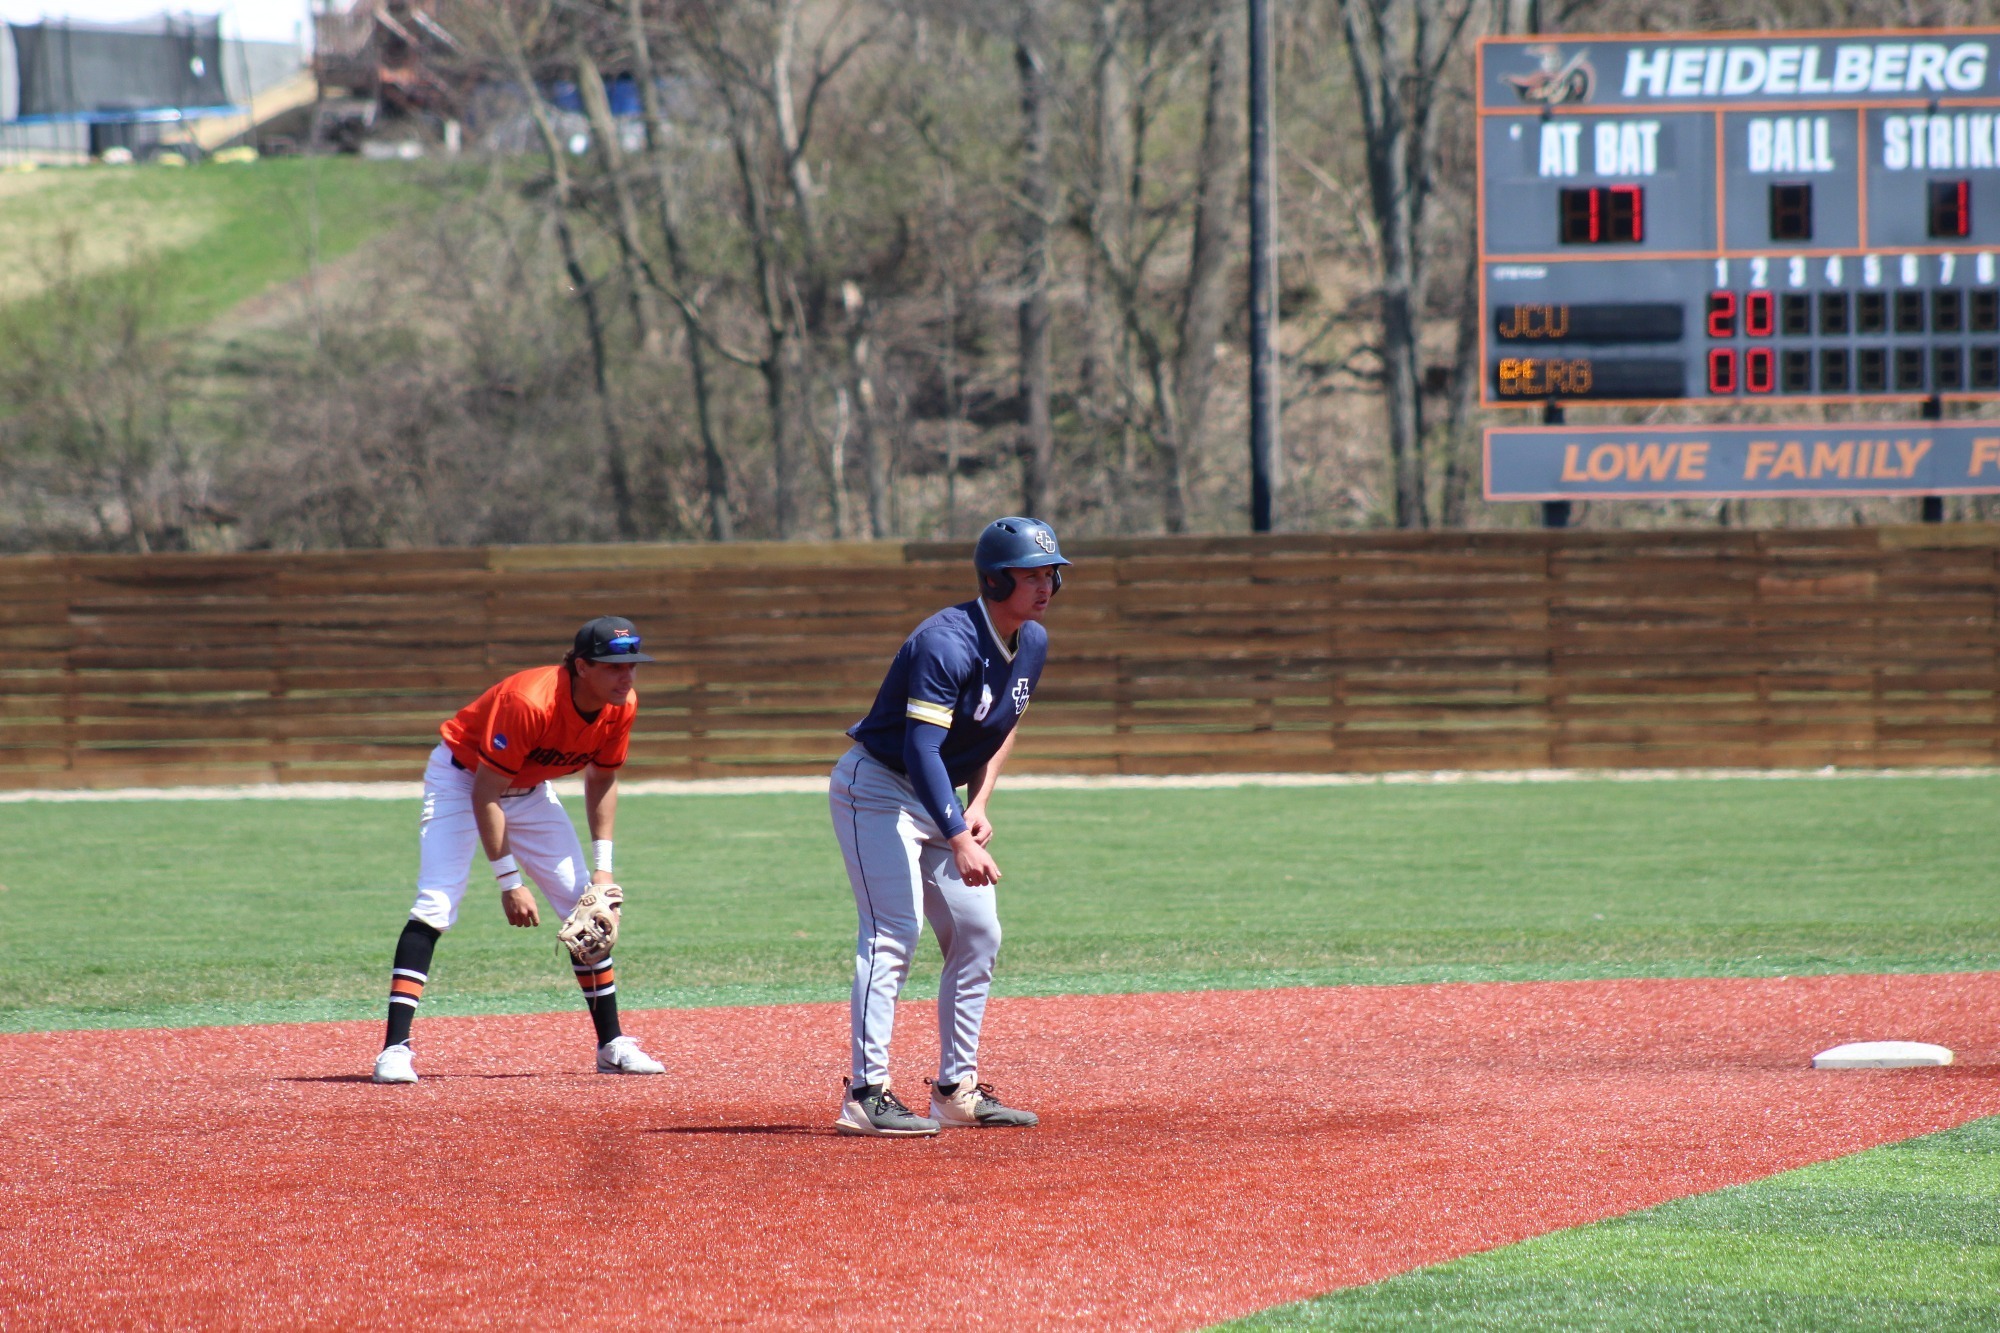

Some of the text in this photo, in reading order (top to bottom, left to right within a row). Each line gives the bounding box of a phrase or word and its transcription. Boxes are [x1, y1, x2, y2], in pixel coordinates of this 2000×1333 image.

[1621, 44, 1988, 97] HEIDELBERG
[1539, 120, 1660, 176] AT BAT
[1748, 118, 1835, 173] BALL
[1589, 184, 1641, 243] 17
[1957, 180, 1968, 236] 1
[1715, 258, 1728, 288] 1
[1751, 257, 1768, 288] 2
[1789, 256, 1806, 287] 3
[1825, 255, 1842, 287] 4
[1863, 254, 1881, 286] 5
[1940, 252, 1955, 285] 7
[1499, 290, 1774, 338] JCU 2 0
[1499, 347, 1774, 394] BERG 0 0
[1560, 441, 1710, 483] LOWE
[1742, 438, 1933, 480] FAMILY
